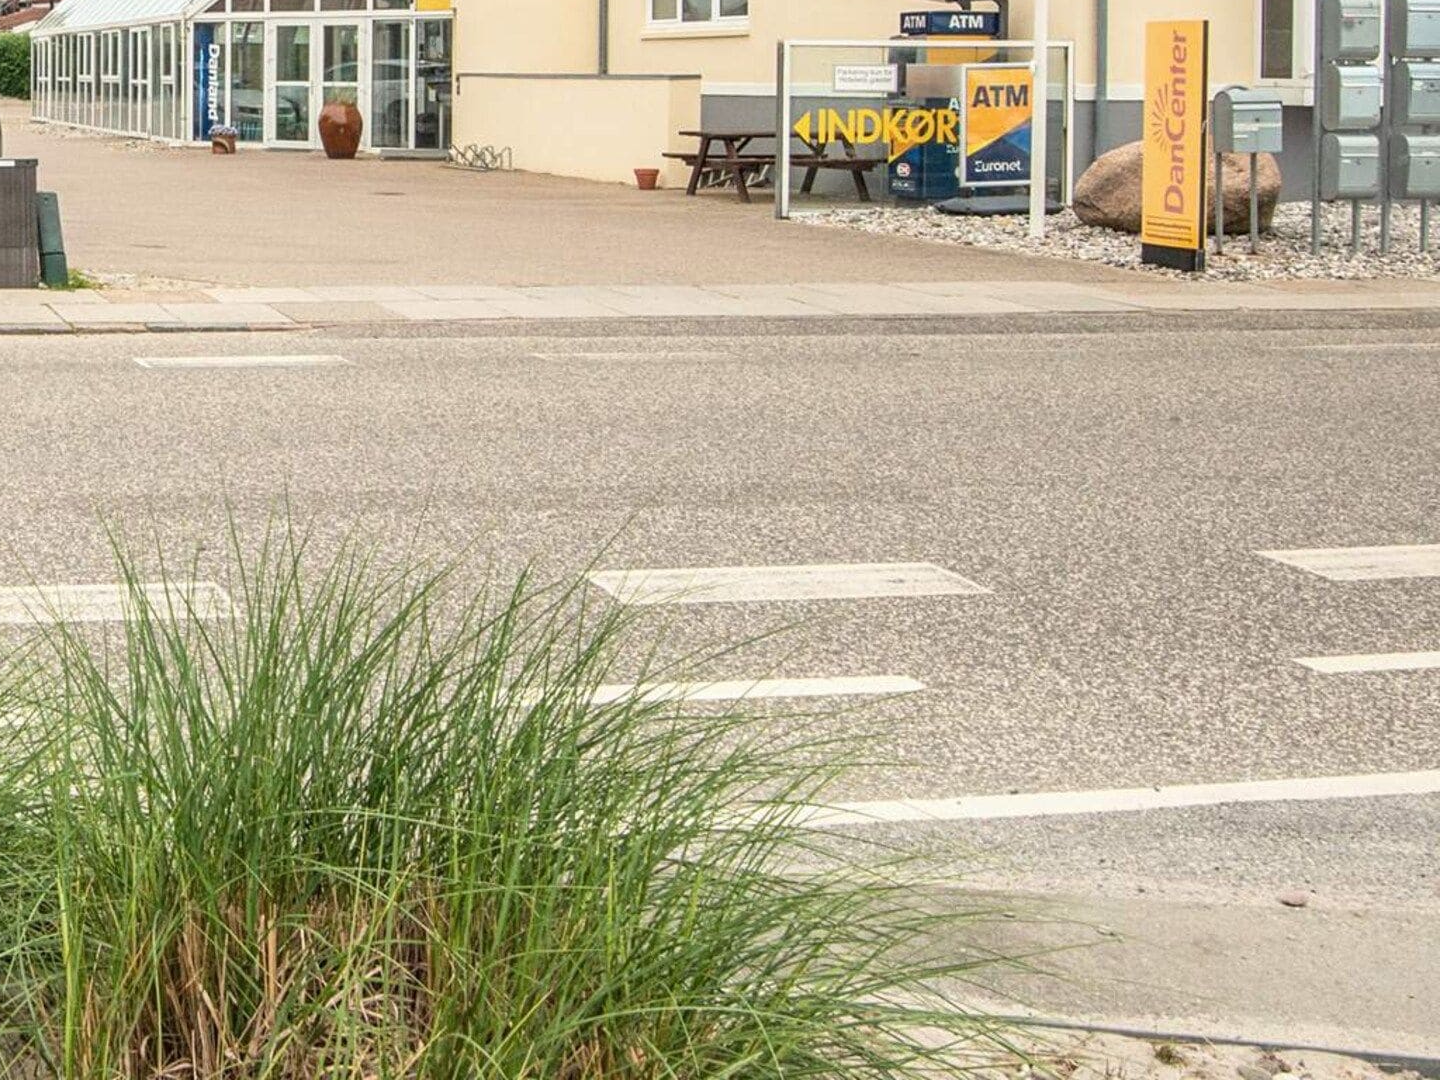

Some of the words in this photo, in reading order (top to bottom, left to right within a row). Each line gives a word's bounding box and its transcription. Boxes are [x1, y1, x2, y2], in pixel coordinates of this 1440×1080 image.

[903, 15, 926, 29] ATM
[949, 15, 983, 29] ATM
[208, 44, 220, 120] Danland
[972, 84, 1029, 108] ATM
[1165, 30, 1187, 214] DanCenter
